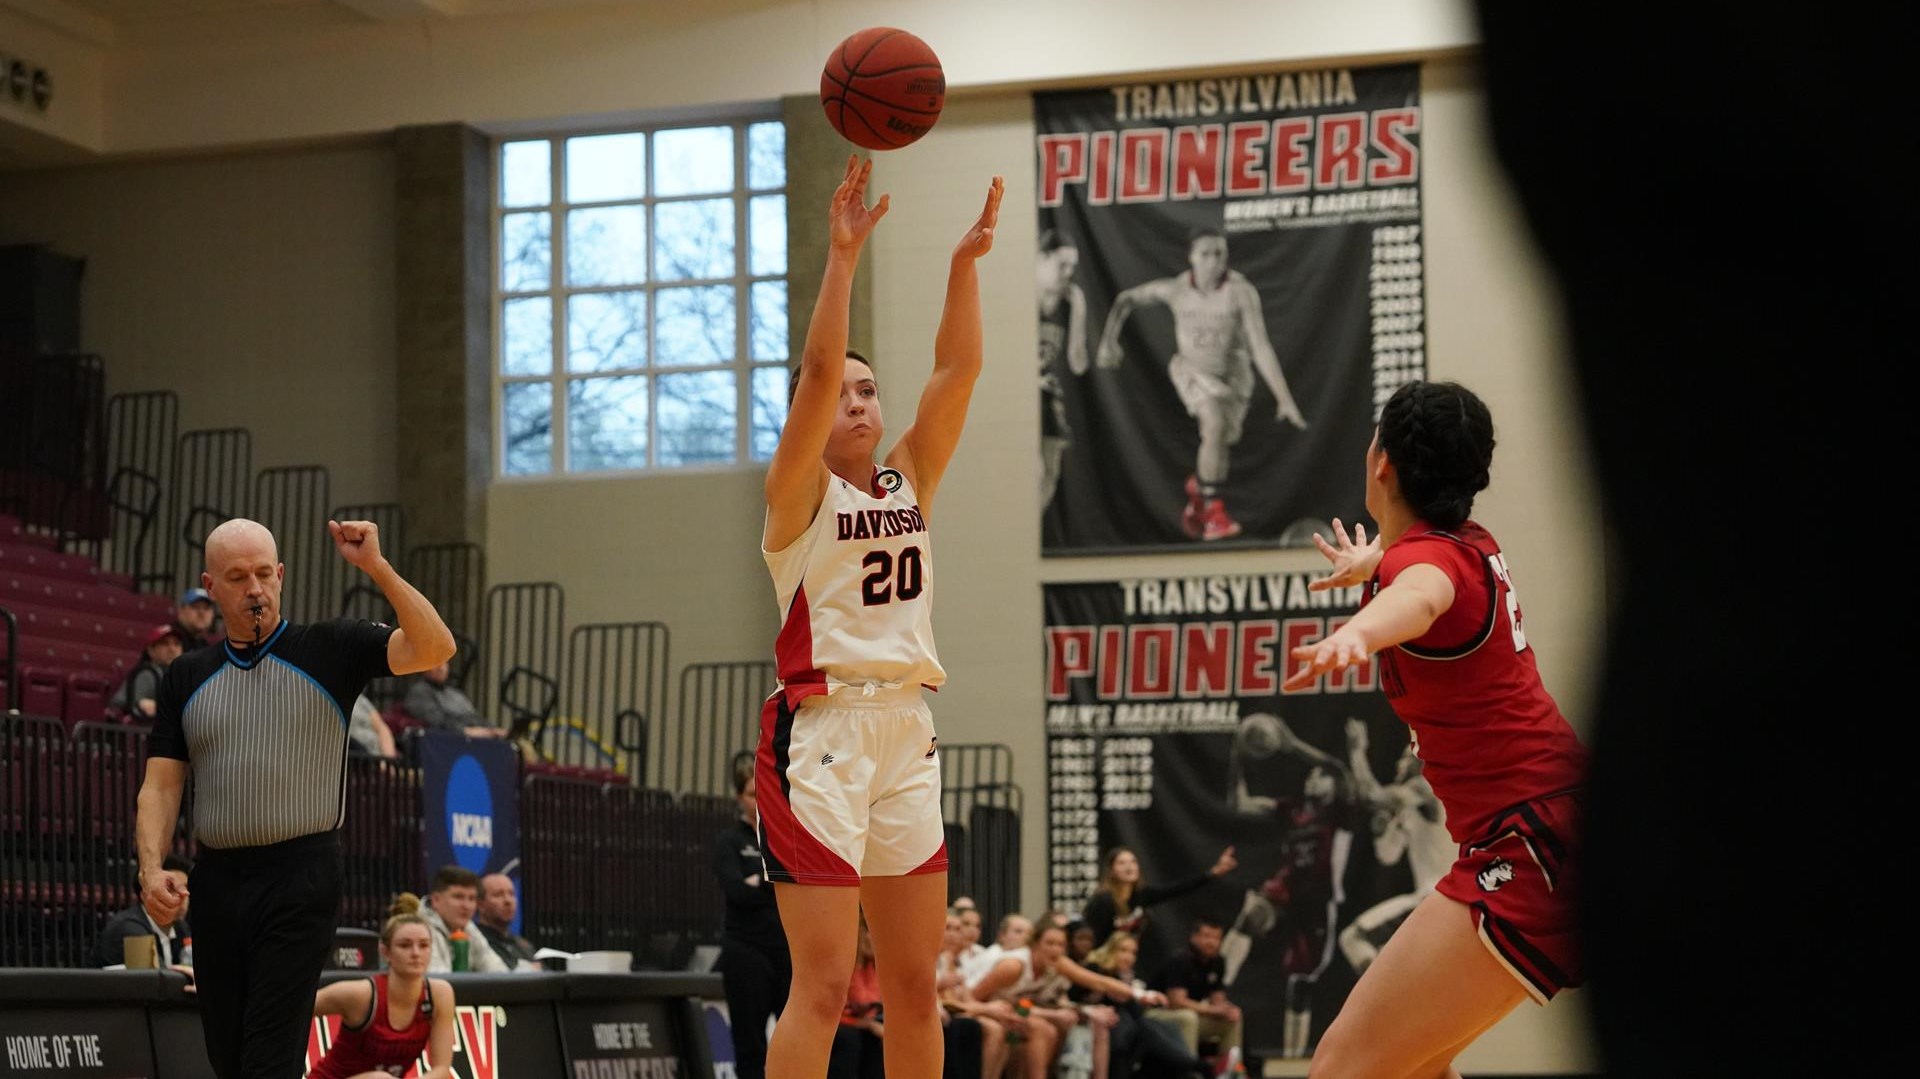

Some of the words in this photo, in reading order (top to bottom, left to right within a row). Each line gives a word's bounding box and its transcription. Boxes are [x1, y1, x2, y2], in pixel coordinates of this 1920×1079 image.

[1110, 69, 1358, 121] TRANSYLVANIA
[1038, 106, 1421, 208] PIONEERS
[1312, 187, 1419, 216] BASKETBALL
[862, 546, 923, 606] 20
[1045, 615, 1384, 700] PIONEE
[1114, 701, 1240, 724] BASKETBALL
[452, 813, 492, 848] NCAA
[6, 1036, 51, 1069] HOME
[52, 1036, 72, 1069] OF
[73, 1035, 103, 1067] THE
[631, 1022, 653, 1048] THE
